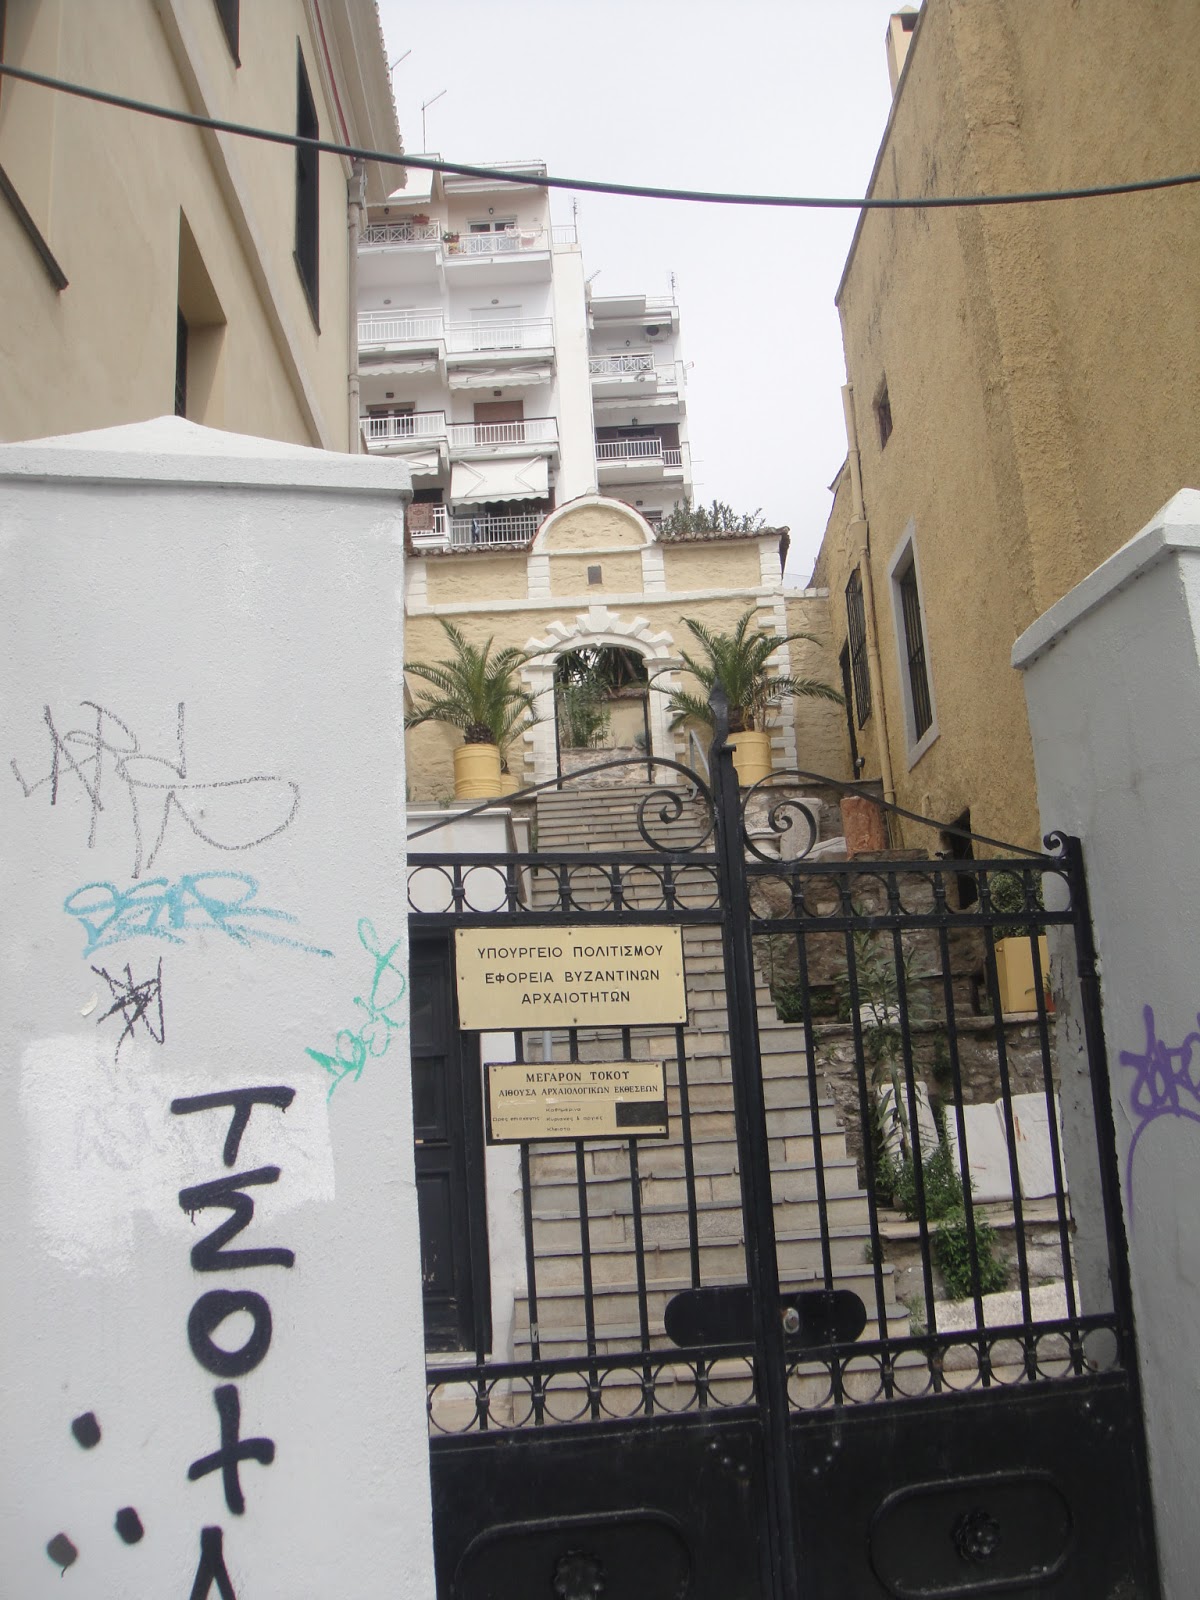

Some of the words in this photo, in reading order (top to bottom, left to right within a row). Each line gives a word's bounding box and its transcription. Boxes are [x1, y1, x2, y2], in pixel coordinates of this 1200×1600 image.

[477, 946, 563, 959] ΥΠΟΥΡΓΕΙΟ
[572, 945, 664, 958] ΠΟΛΙΤΙΣΜΟΥ
[484, 971, 554, 984] ΕΦΟΡΕΙΑ
[564, 969, 660, 983] ΒΥΖΑΝΤΙΝΩΝ
[521, 990, 631, 1005] ΑΡΧΑΙΟΤΗΤΩΝ
[525, 1072, 582, 1083] ΜΕΓΑΡΟΝ
[589, 1070, 630, 1081] ΤΟΚΟΥ
[498, 1087, 537, 1097] ΑΙΘΟΥΣΑ
[541, 1086, 610, 1096] ΑΡΧΑΙΟΛΟΓΙΚΩΝ
[614, 1085, 658, 1094] ΕΚΘΕΣΕΩΝ
